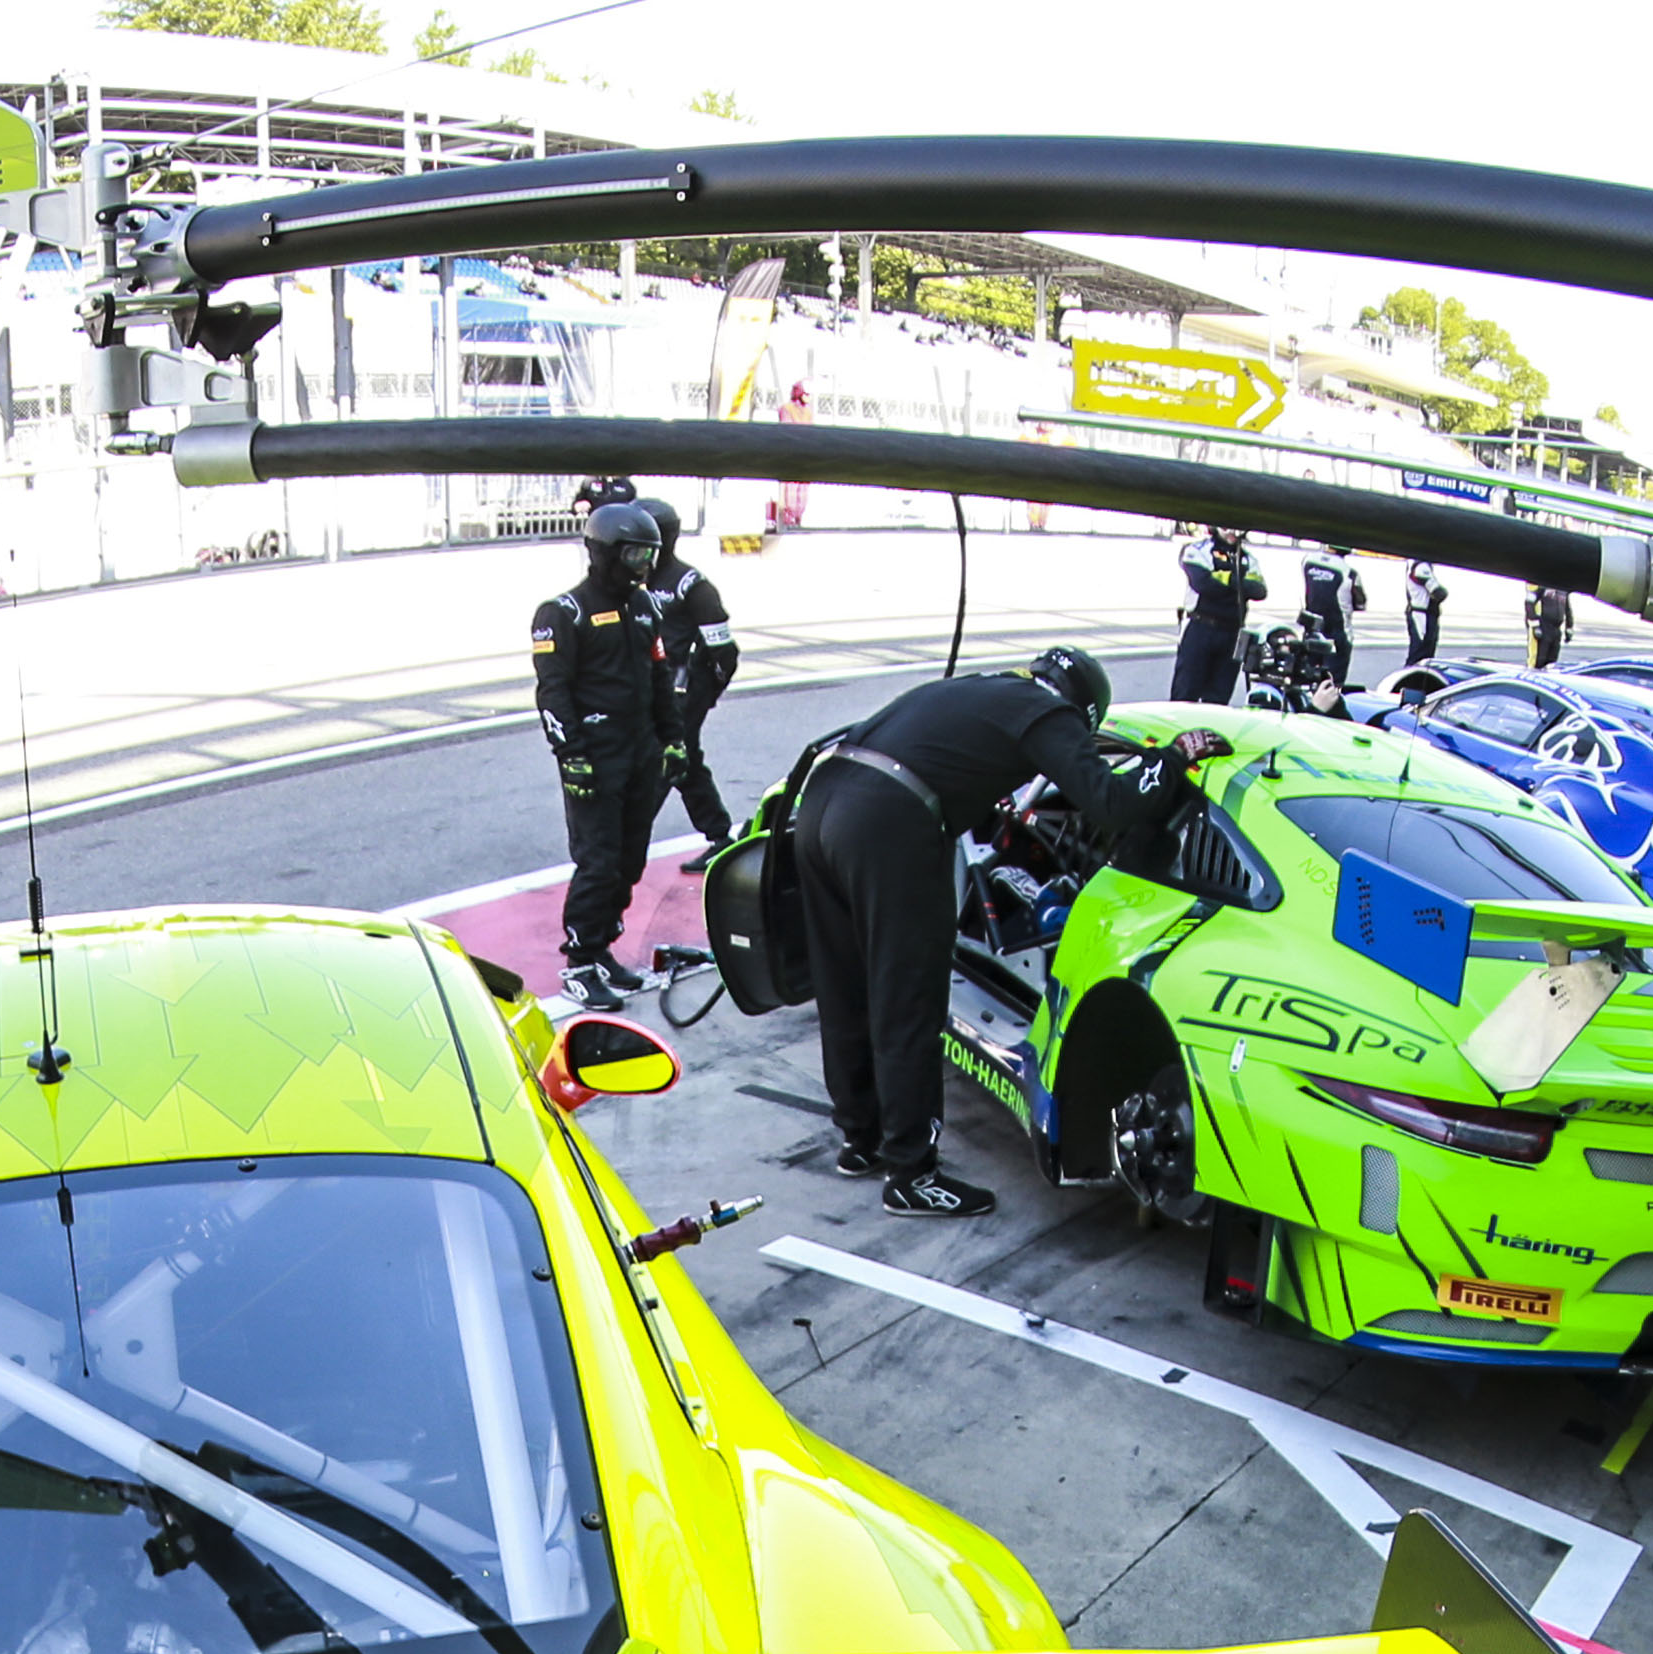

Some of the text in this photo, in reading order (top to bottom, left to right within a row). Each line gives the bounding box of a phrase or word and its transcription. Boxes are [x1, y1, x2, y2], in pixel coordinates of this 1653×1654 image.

[1426, 474, 1488, 498] Emil Frey
[1451, 1279, 1552, 1316] PIRELLI
